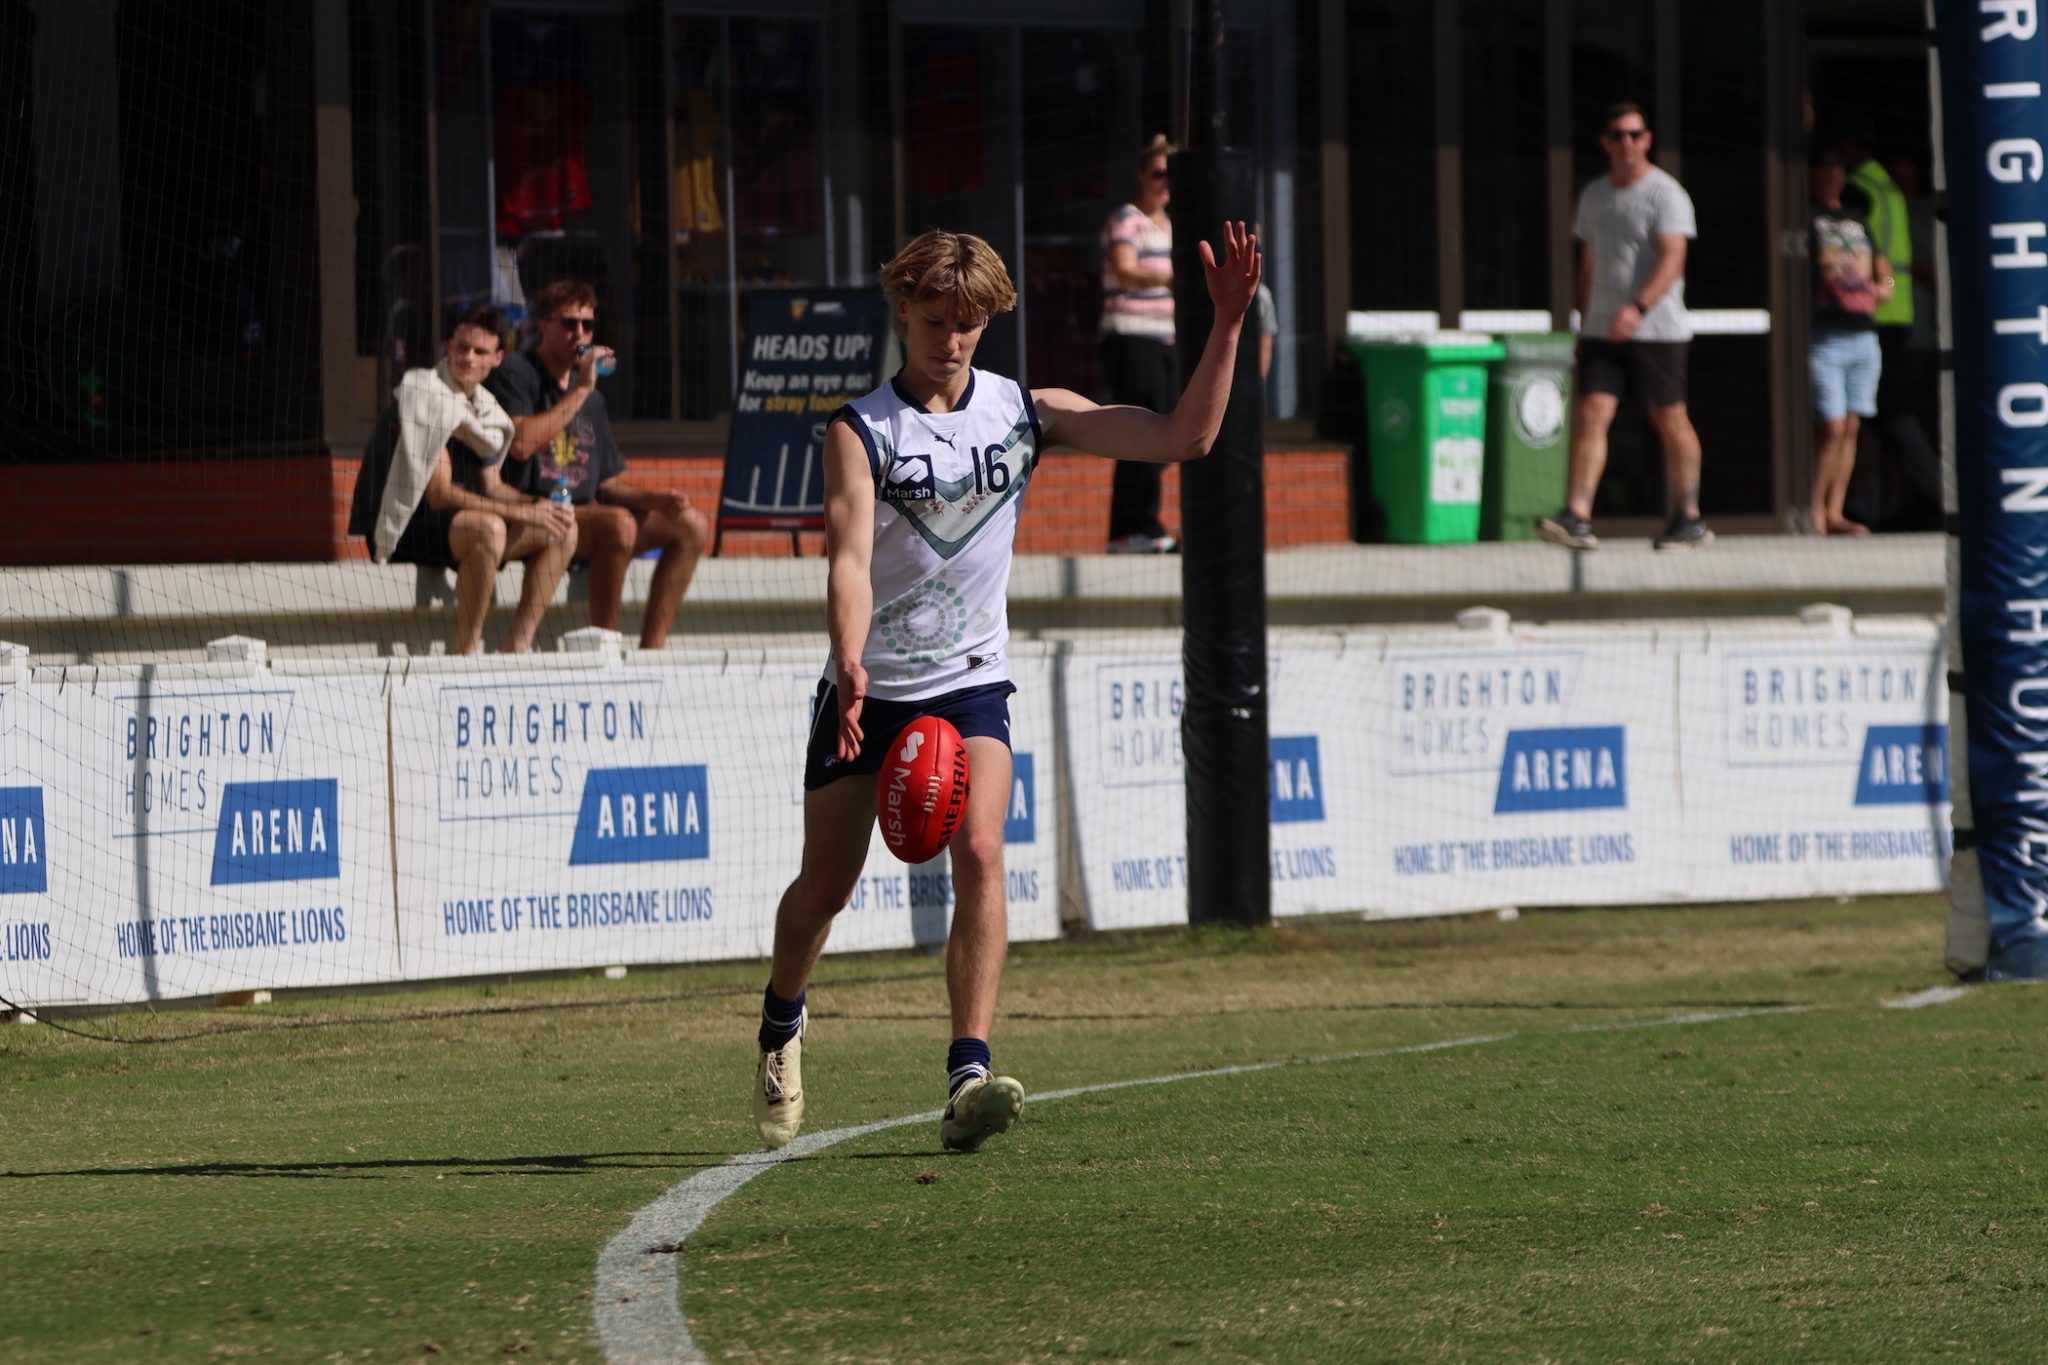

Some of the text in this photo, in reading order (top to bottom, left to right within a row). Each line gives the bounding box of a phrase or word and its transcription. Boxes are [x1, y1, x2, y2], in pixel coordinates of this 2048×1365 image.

[1980, 0, 2048, 513] RIGHTON
[753, 334, 872, 360] HEADS UP!
[744, 369, 872, 394] Keep an eye out
[739, 392, 761, 412] for
[765, 395, 807, 416] stray
[970, 443, 1010, 496] 16
[887, 487, 931, 499] Marsh
[1111, 680, 1183, 720] BRIG
[1402, 667, 1561, 711] BRIGHTON
[1744, 668, 1917, 704] BRIGHTON
[126, 711, 274, 761] BRIGHTON
[457, 701, 644, 748] BRIGHTON
[1401, 717, 1490, 756] HOMES
[1744, 712, 1850, 749] HOMES
[1112, 727, 1183, 767] HOME
[1869, 743, 1944, 787] AREN
[125, 768, 207, 815] HOMES
[456, 755, 563, 799] HOMES
[1513, 747, 1617, 792] ARENA
[597, 791, 700, 838] ARENA
[888, 767, 911, 846] Marsh
[937, 743, 967, 850] SHERRIN
[231, 806, 328, 857] ARENA
[1730, 832, 1782, 864] HOME
[1789, 831, 1809, 861] OF
[1815, 830, 1849, 861] THE
[1852, 827, 1933, 859] BRISBANE
[1112, 857, 1154, 892] HOME
[1156, 855, 1174, 890] OF
[1286, 846, 1337, 880] LIONS
[1394, 832, 1636, 876] HOME OF THE BRISBANE LIONS
[443, 886, 713, 936] HOME OF THE BRISBANE LIONS
[873, 875, 903, 910] THE
[1004, 869, 1040, 903] IONS
[7, 921, 51, 961] LIONS
[117, 906, 346, 958] HOME OF THE BRISBANE LIONS
